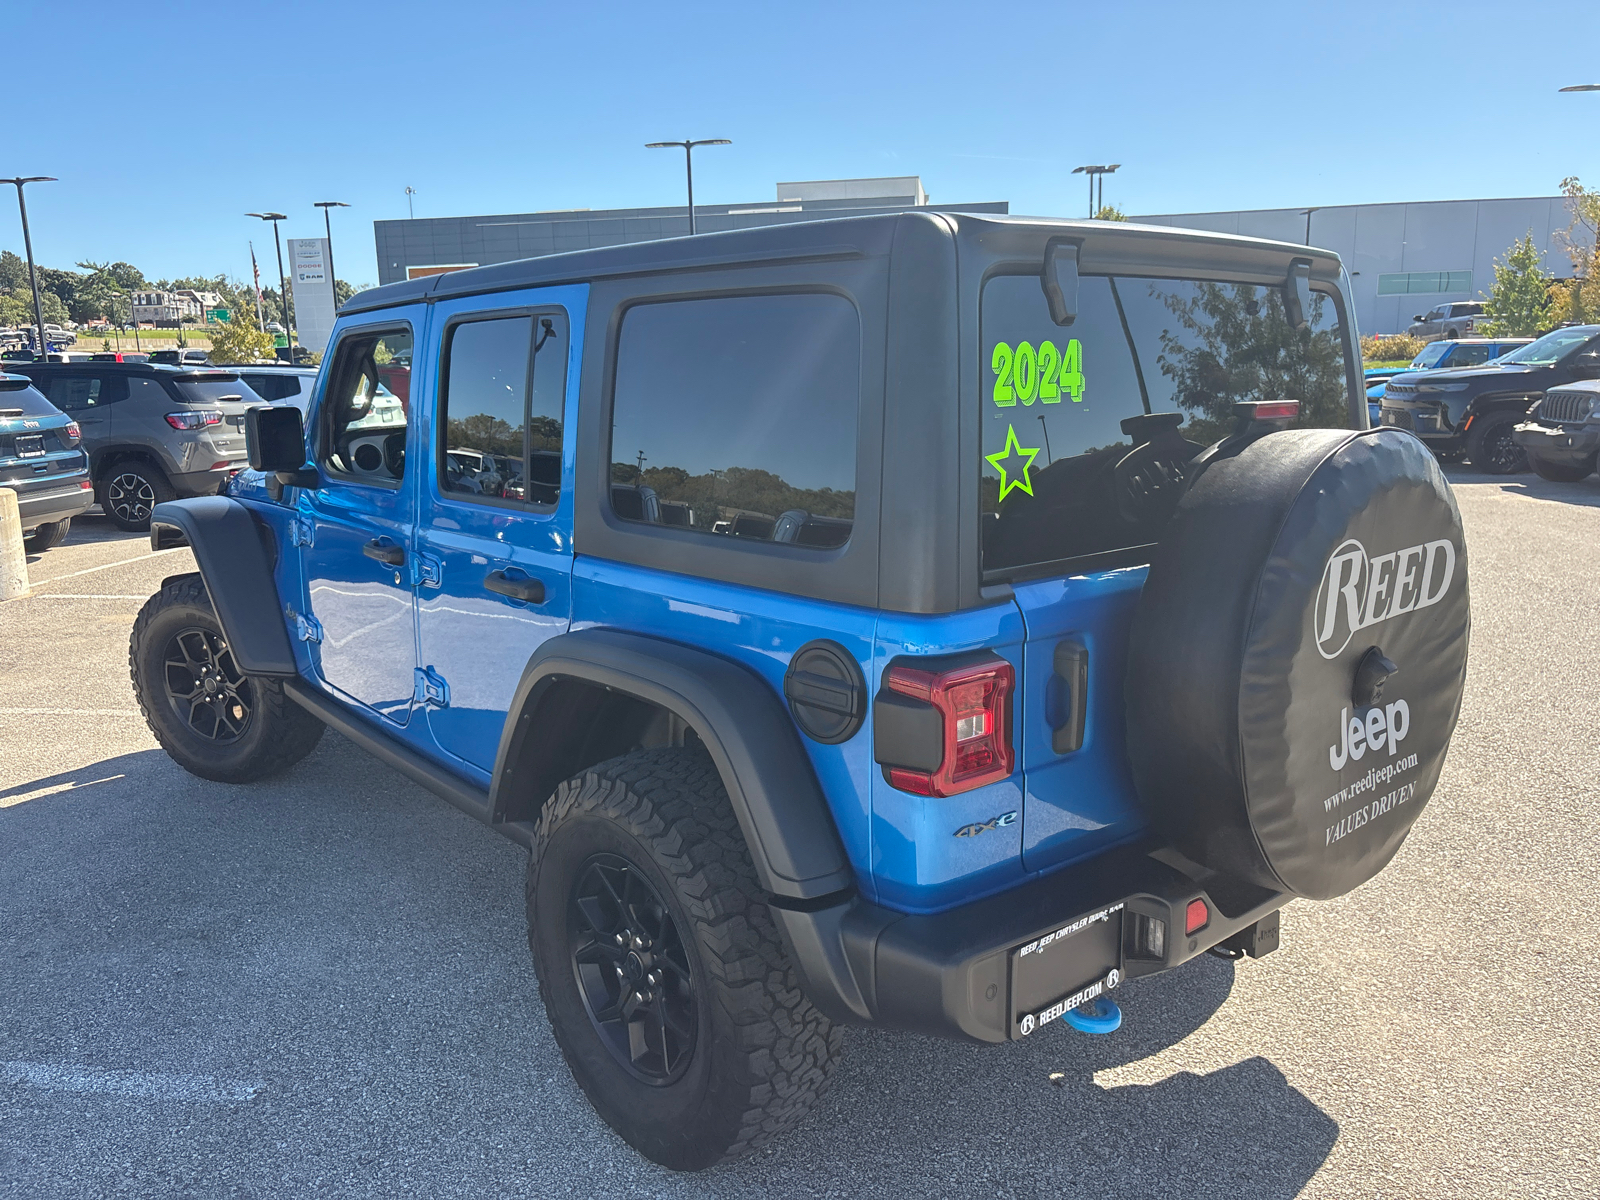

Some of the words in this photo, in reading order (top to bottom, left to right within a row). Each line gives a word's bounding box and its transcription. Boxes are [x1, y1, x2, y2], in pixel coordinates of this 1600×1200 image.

[992, 339, 1085, 407] 2024
[1314, 539, 1456, 660] REED
[1329, 698, 1411, 771] Jeep
[1323, 752, 1419, 813] www.reedjeep.com
[1324, 803, 1370, 847] VALUES
[1370, 780, 1417, 820] DRIVEN
[1020, 941, 1038, 958] REED
[1039, 932, 1056, 949] JEEP
[1055, 917, 1088, 940] CHRYSLER
[1039, 982, 1102, 1027] REEDJEEP.COM
